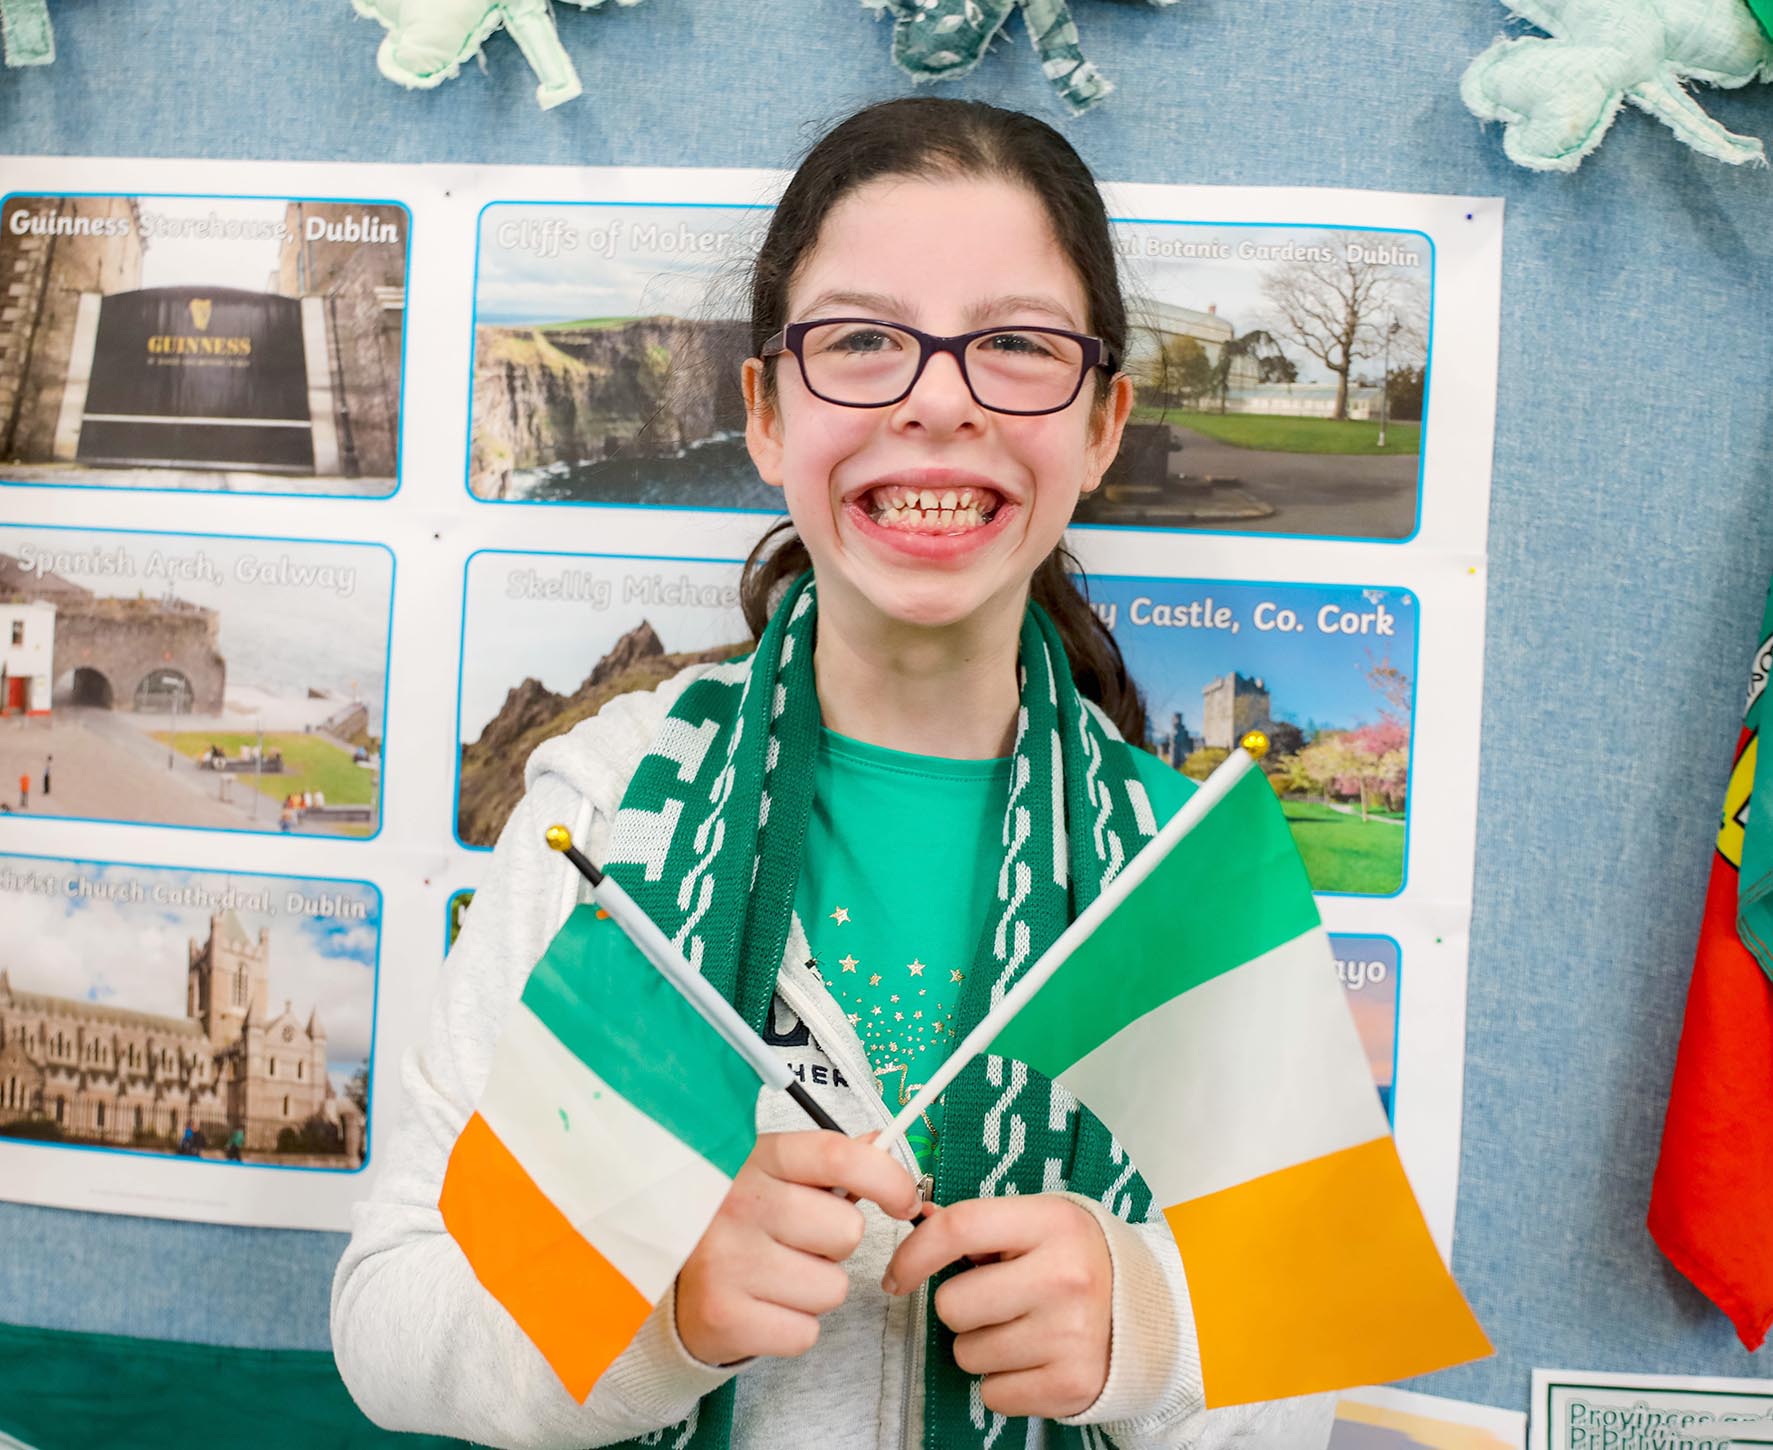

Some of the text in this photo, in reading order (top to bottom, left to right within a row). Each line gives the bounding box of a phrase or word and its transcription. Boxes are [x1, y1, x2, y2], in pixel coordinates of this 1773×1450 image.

[9, 209, 130, 237] Guinness
[305, 216, 399, 244] Dublin
[498, 219, 578, 257] Cliffs
[589, 219, 624, 258] of
[1146, 239, 1230, 261] Botanic
[1347, 244, 1420, 267] Dublin
[147, 335, 252, 356] GUINNESS
[17, 545, 135, 578] Spanish
[235, 553, 356, 596] Galway
[506, 569, 741, 609] Skellig Michae
[1129, 597, 1240, 633] Castle,
[1253, 602, 1304, 632] Co.
[1316, 604, 1395, 635] Cork
[62, 874, 145, 901] Church
[286, 890, 367, 919] Dublin
